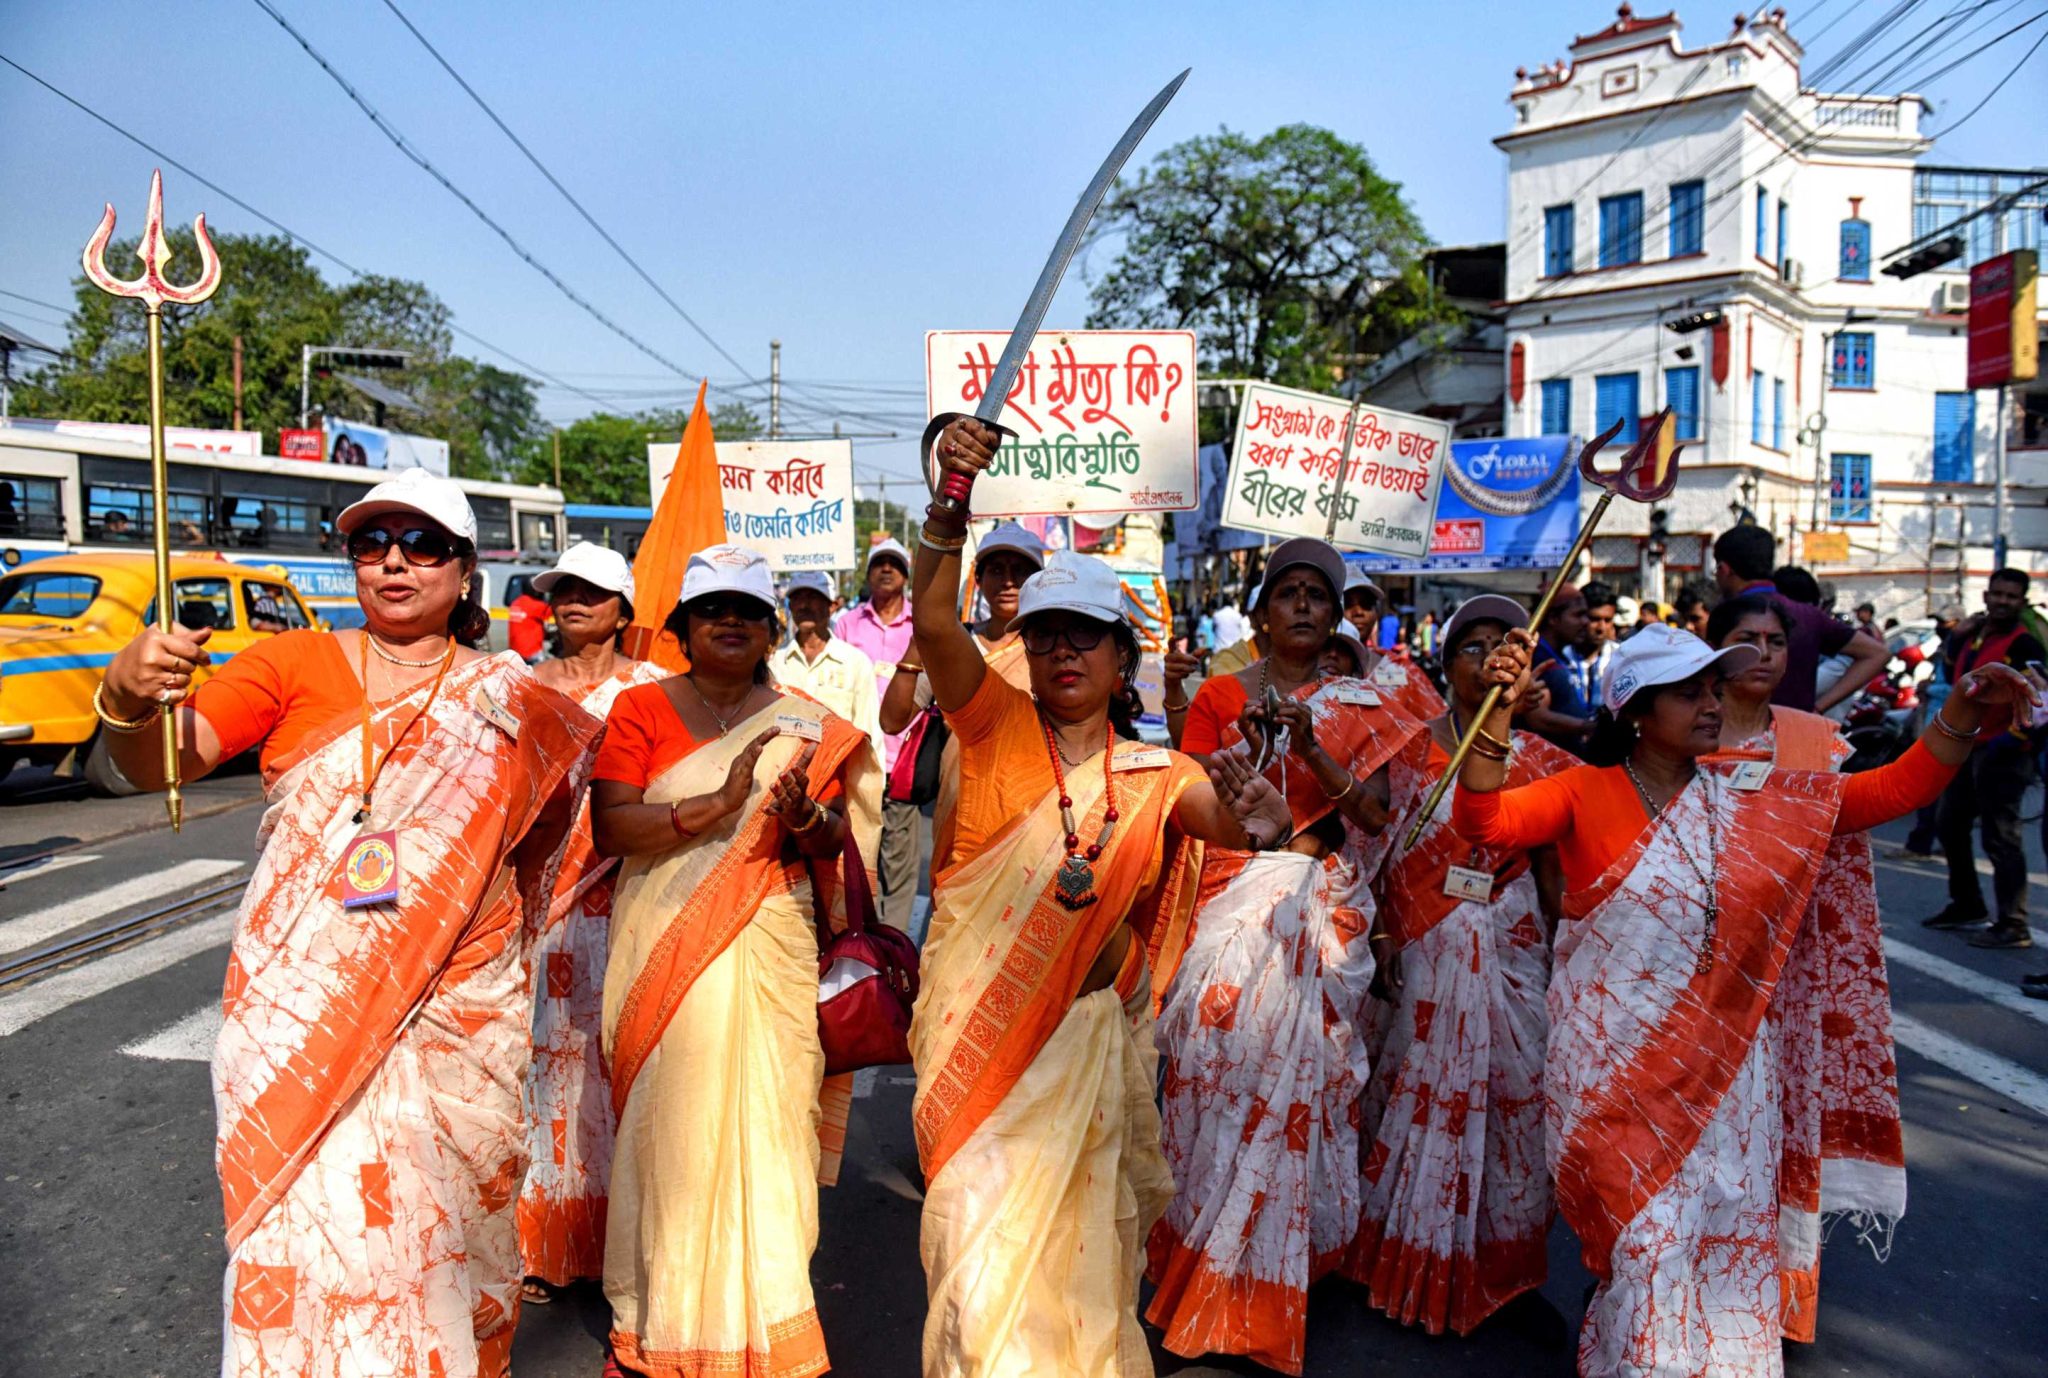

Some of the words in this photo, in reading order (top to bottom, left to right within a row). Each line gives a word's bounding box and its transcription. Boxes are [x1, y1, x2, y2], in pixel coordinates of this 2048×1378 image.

[1047, 344, 1133, 435] মৃত্যু
[1124, 344, 1183, 422] কি?
[1245, 400, 1315, 438] সংগ্রাম
[1398, 431, 1440, 464] ভাবে
[764, 458, 826, 498] করিবে
[1240, 469, 1307, 518] বীরের
[745, 508, 792, 539] তেমনি
[795, 499, 844, 537] করিবে
[316, 574, 356, 594] TRANS
